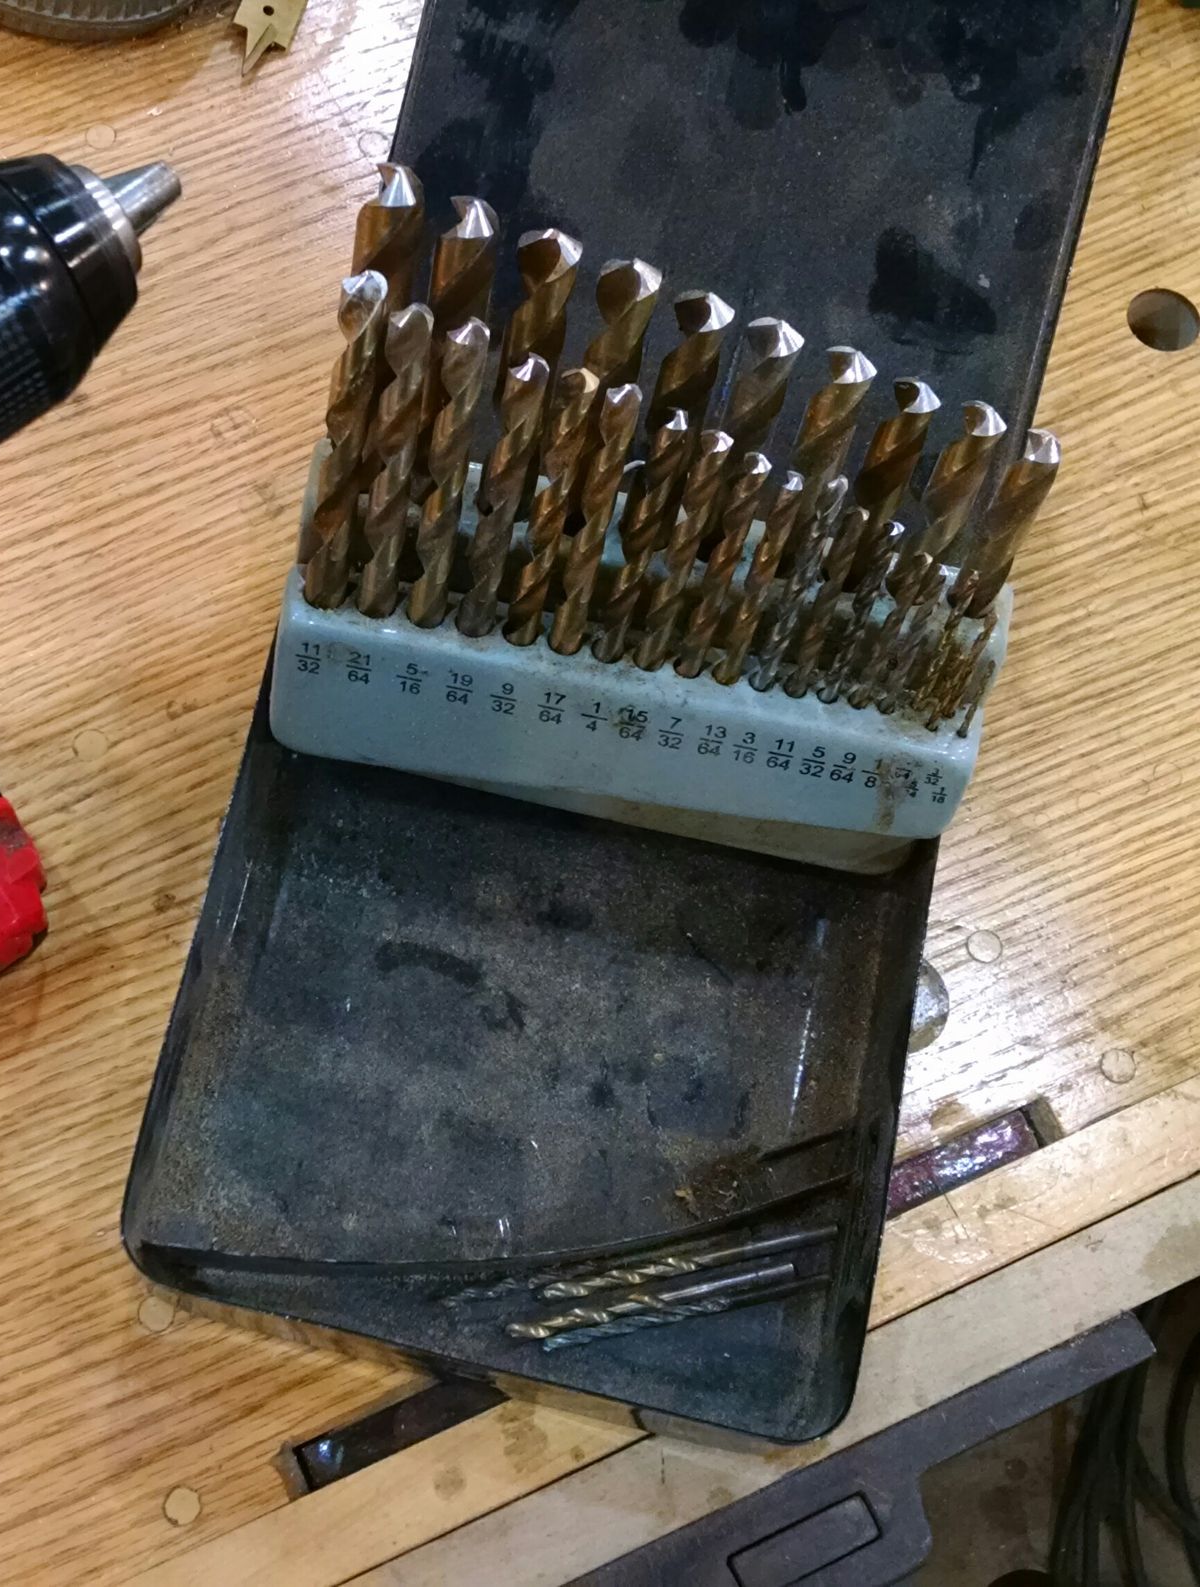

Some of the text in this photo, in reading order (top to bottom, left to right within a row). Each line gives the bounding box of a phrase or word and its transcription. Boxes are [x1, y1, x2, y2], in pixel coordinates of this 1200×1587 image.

[301, 642, 321, 655] 11
[350, 651, 372, 666] 21
[297, 659, 320, 675] 32
[406, 663, 419, 676] 5
[348, 670, 370, 685] 64
[450, 672, 474, 687] 19
[400, 680, 421, 695] 16
[501, 682, 514, 696] 9
[446, 690, 469, 706] 64
[543, 691, 567, 706] 17
[492, 700, 516, 715] 32
[593, 701, 602, 714] 1
[538, 709, 563, 726] 64
[670, 716, 683, 729] 7
[586, 719, 599, 733] 4
[619, 726, 643, 741] 64
[705, 724, 727, 739] 13
[658, 734, 682, 750] 32
[743, 732, 756, 745] 3
[775, 738, 796, 752] 11
[698, 741, 721, 757] 64
[734, 748, 755, 765] 16
[812, 745, 826, 759] 5
[767, 755, 790, 771] 64
[843, 752, 856, 766] 9
[800, 762, 824, 778] 32
[830, 768, 855, 784] 64
[864, 776, 877, 788] 8
